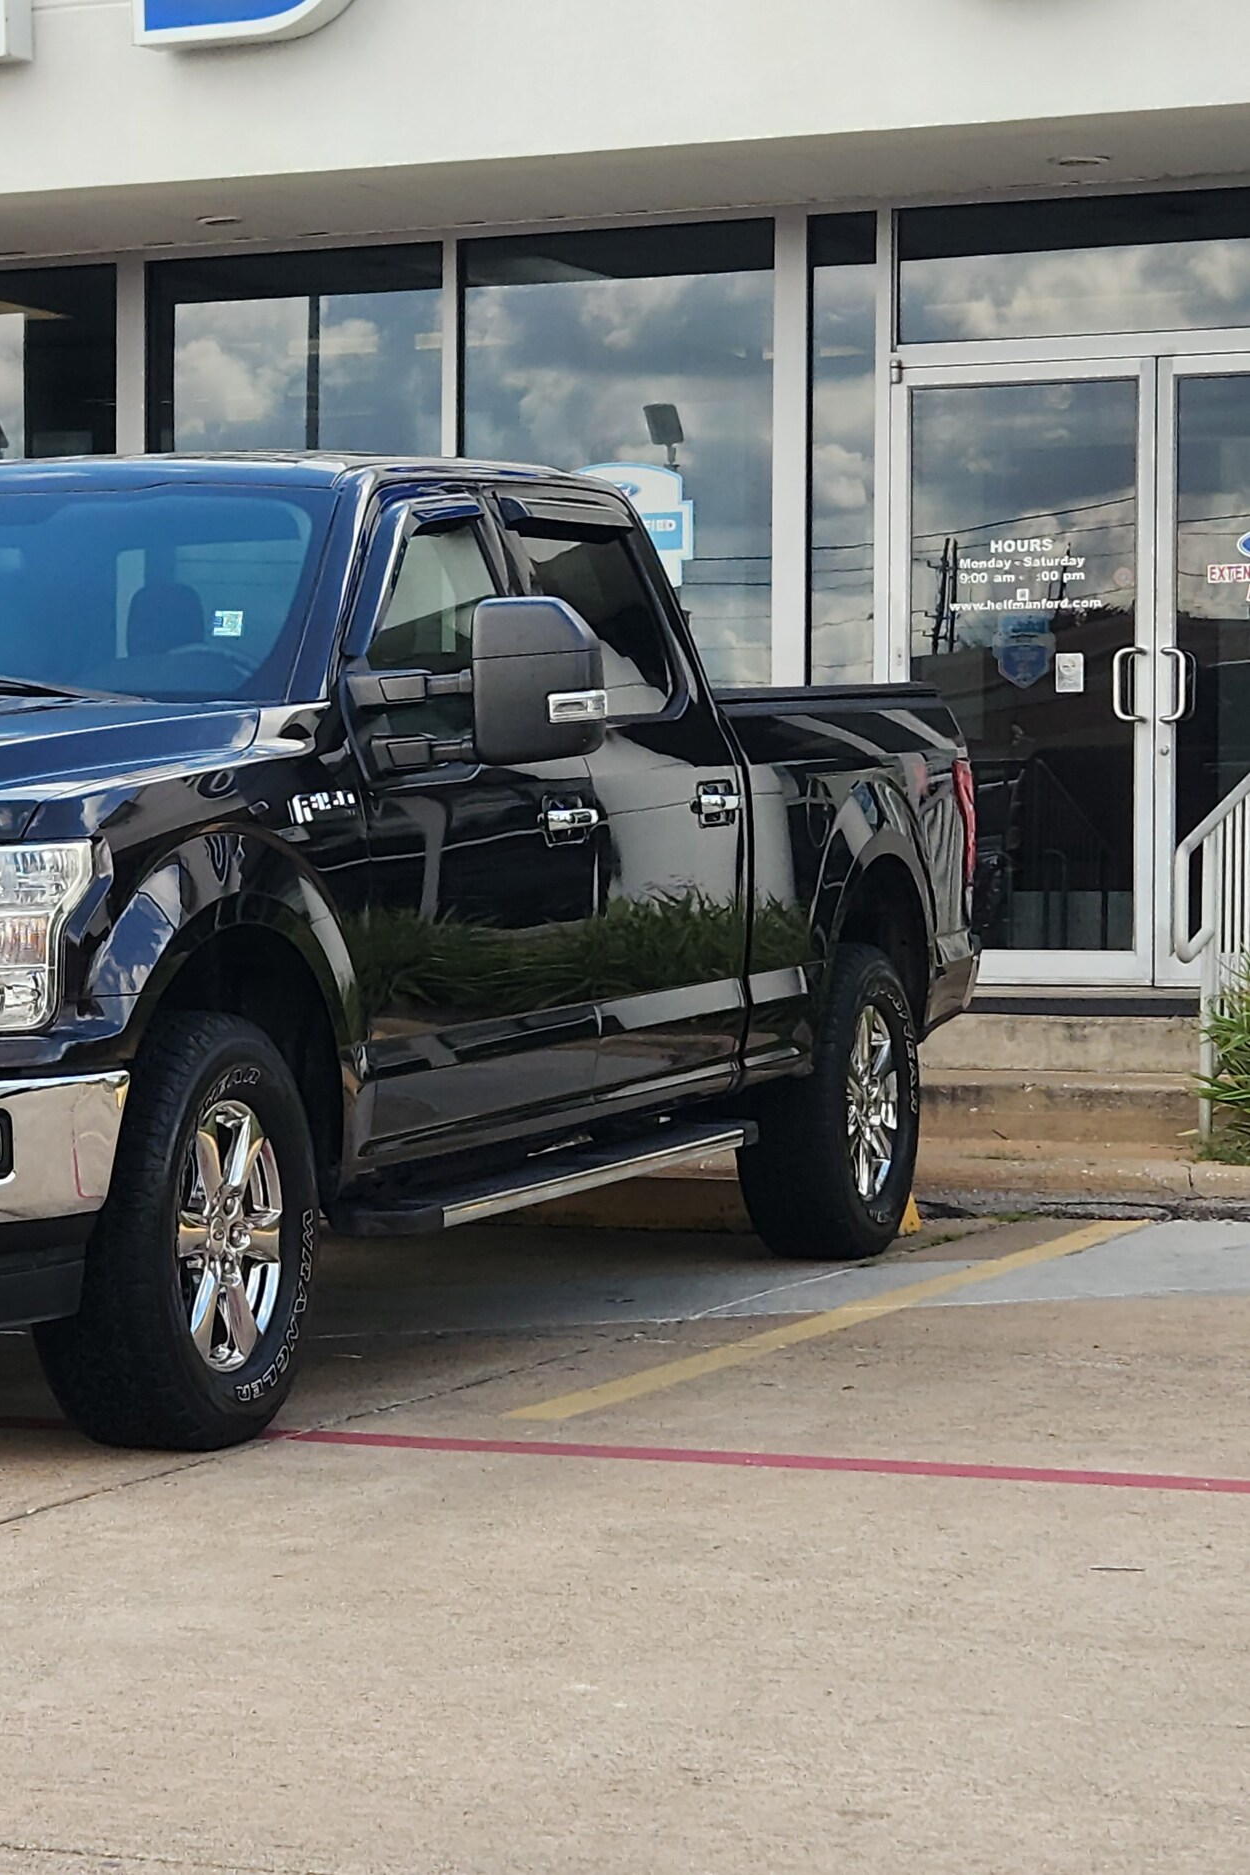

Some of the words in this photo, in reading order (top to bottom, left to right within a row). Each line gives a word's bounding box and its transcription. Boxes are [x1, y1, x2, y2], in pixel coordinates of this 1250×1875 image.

[989, 538, 1053, 553] HOURS
[959, 557, 1012, 570] Monday
[1023, 556, 1086, 568] Saturday
[959, 572, 988, 583] 9:00
[993, 574, 1015, 583] am
[1063, 572, 1085, 584] pm
[236, 1207, 316, 1403] WRANGLER
